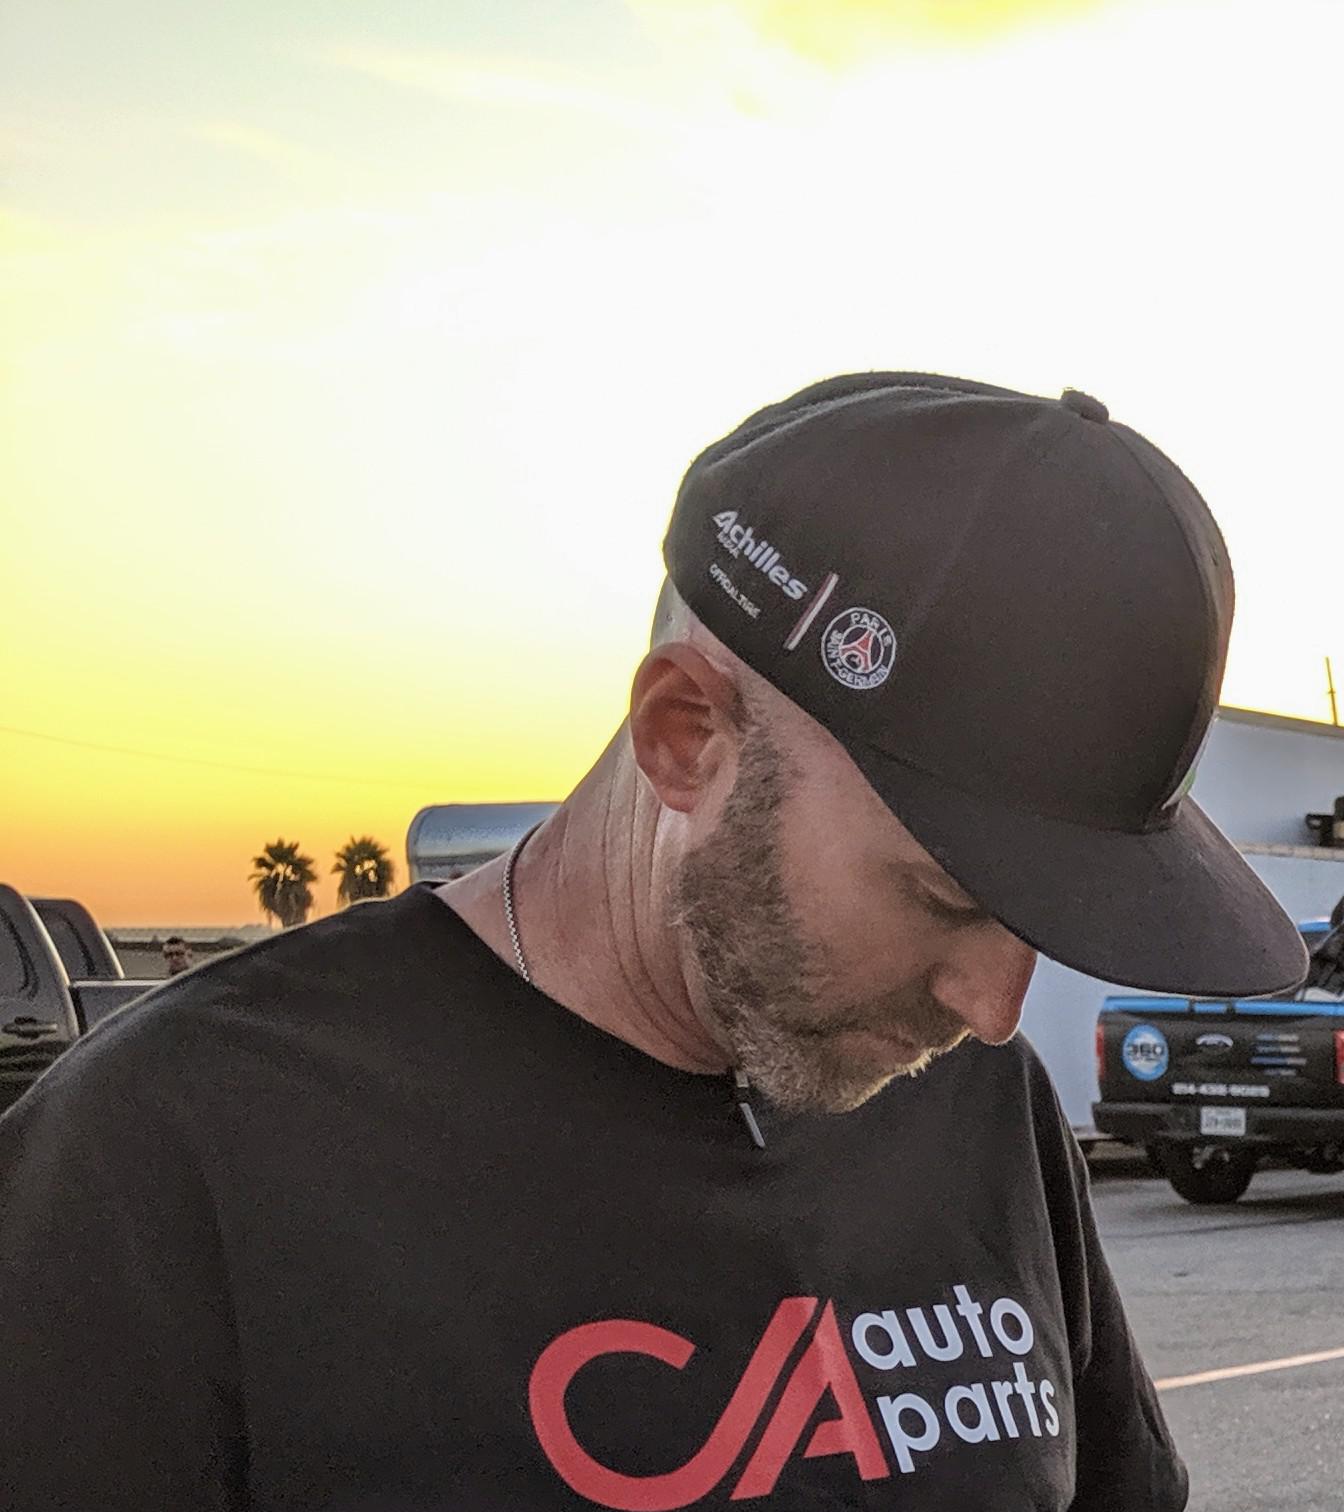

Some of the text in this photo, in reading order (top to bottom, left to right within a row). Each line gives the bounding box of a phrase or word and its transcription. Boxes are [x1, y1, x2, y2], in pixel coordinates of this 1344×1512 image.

[712, 510, 808, 600] Achilles
[850, 612, 892, 647] PARIS
[851, 1284, 1035, 1371] auto
[528, 1296, 891, 1512] CA
[876, 1361, 1060, 1474] parts
